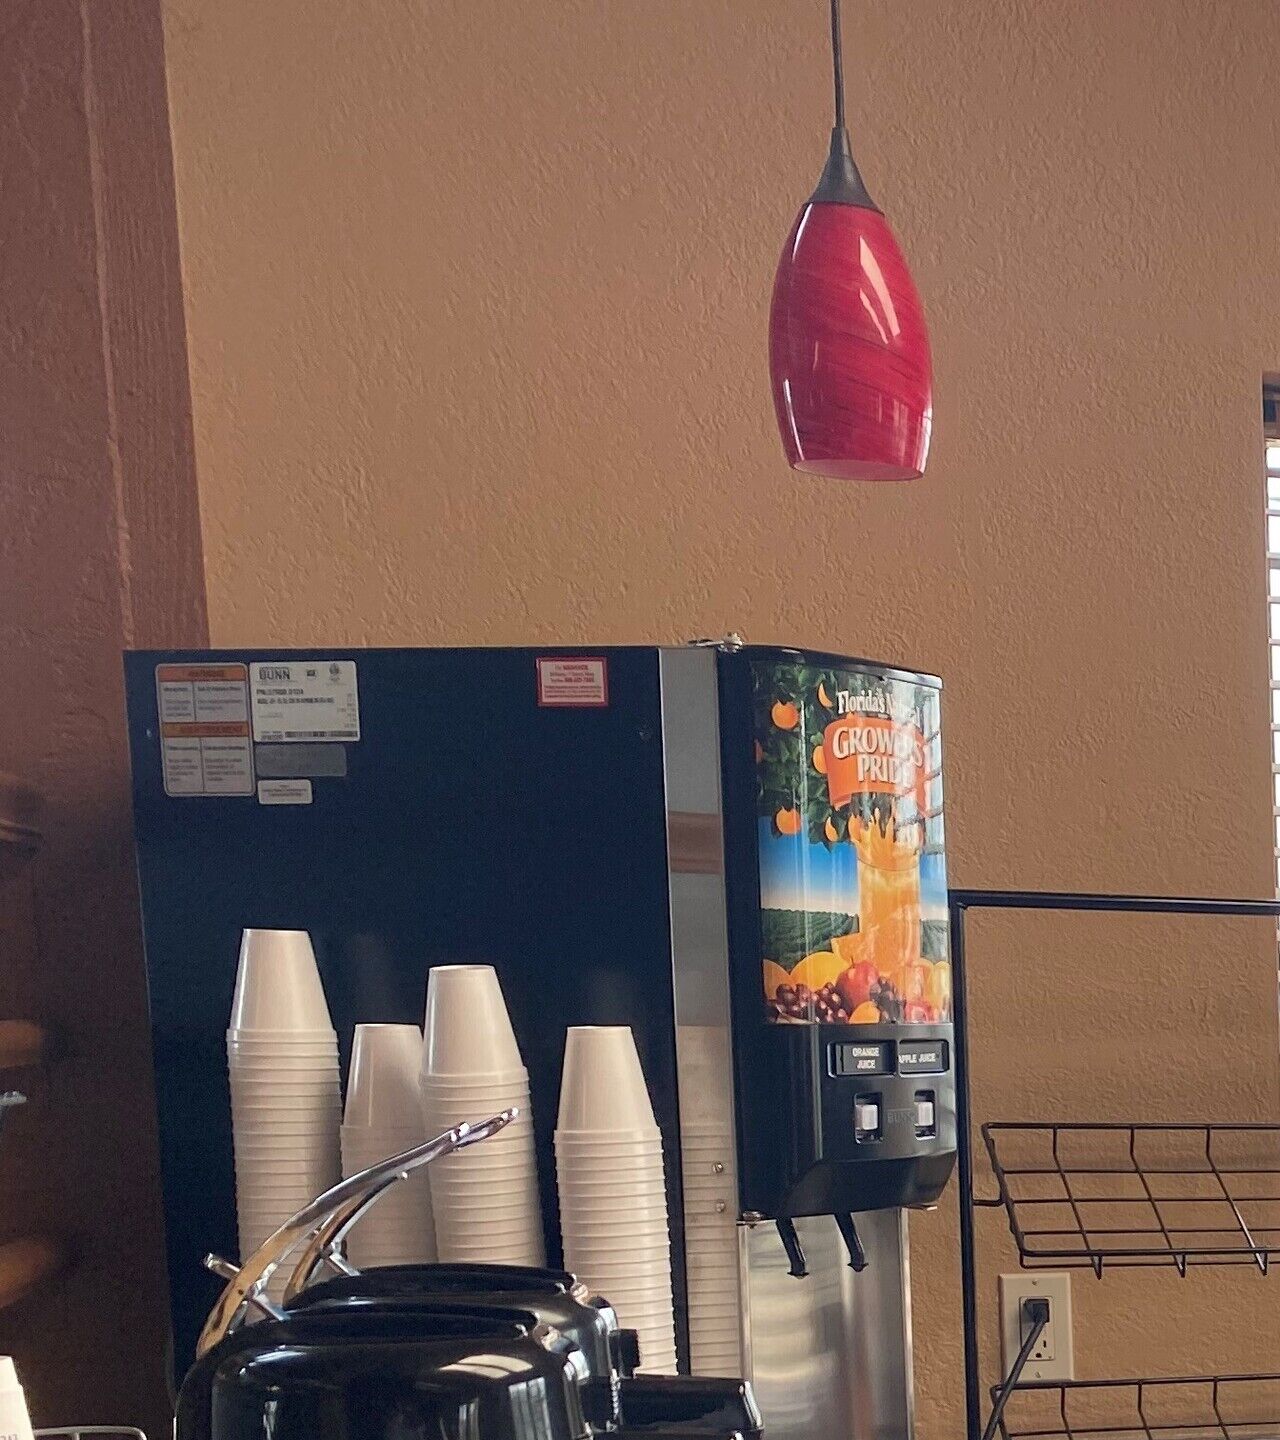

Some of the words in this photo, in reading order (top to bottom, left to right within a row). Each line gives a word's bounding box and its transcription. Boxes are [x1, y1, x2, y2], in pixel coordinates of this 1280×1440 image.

[837, 687, 887, 714] Florida's
[852, 1047, 880, 1058] ORANGE
[898, 1054, 917, 1065] APPLE
[919, 1053, 936, 1063] JUICE
[856, 1060, 876, 1070] JUICE
